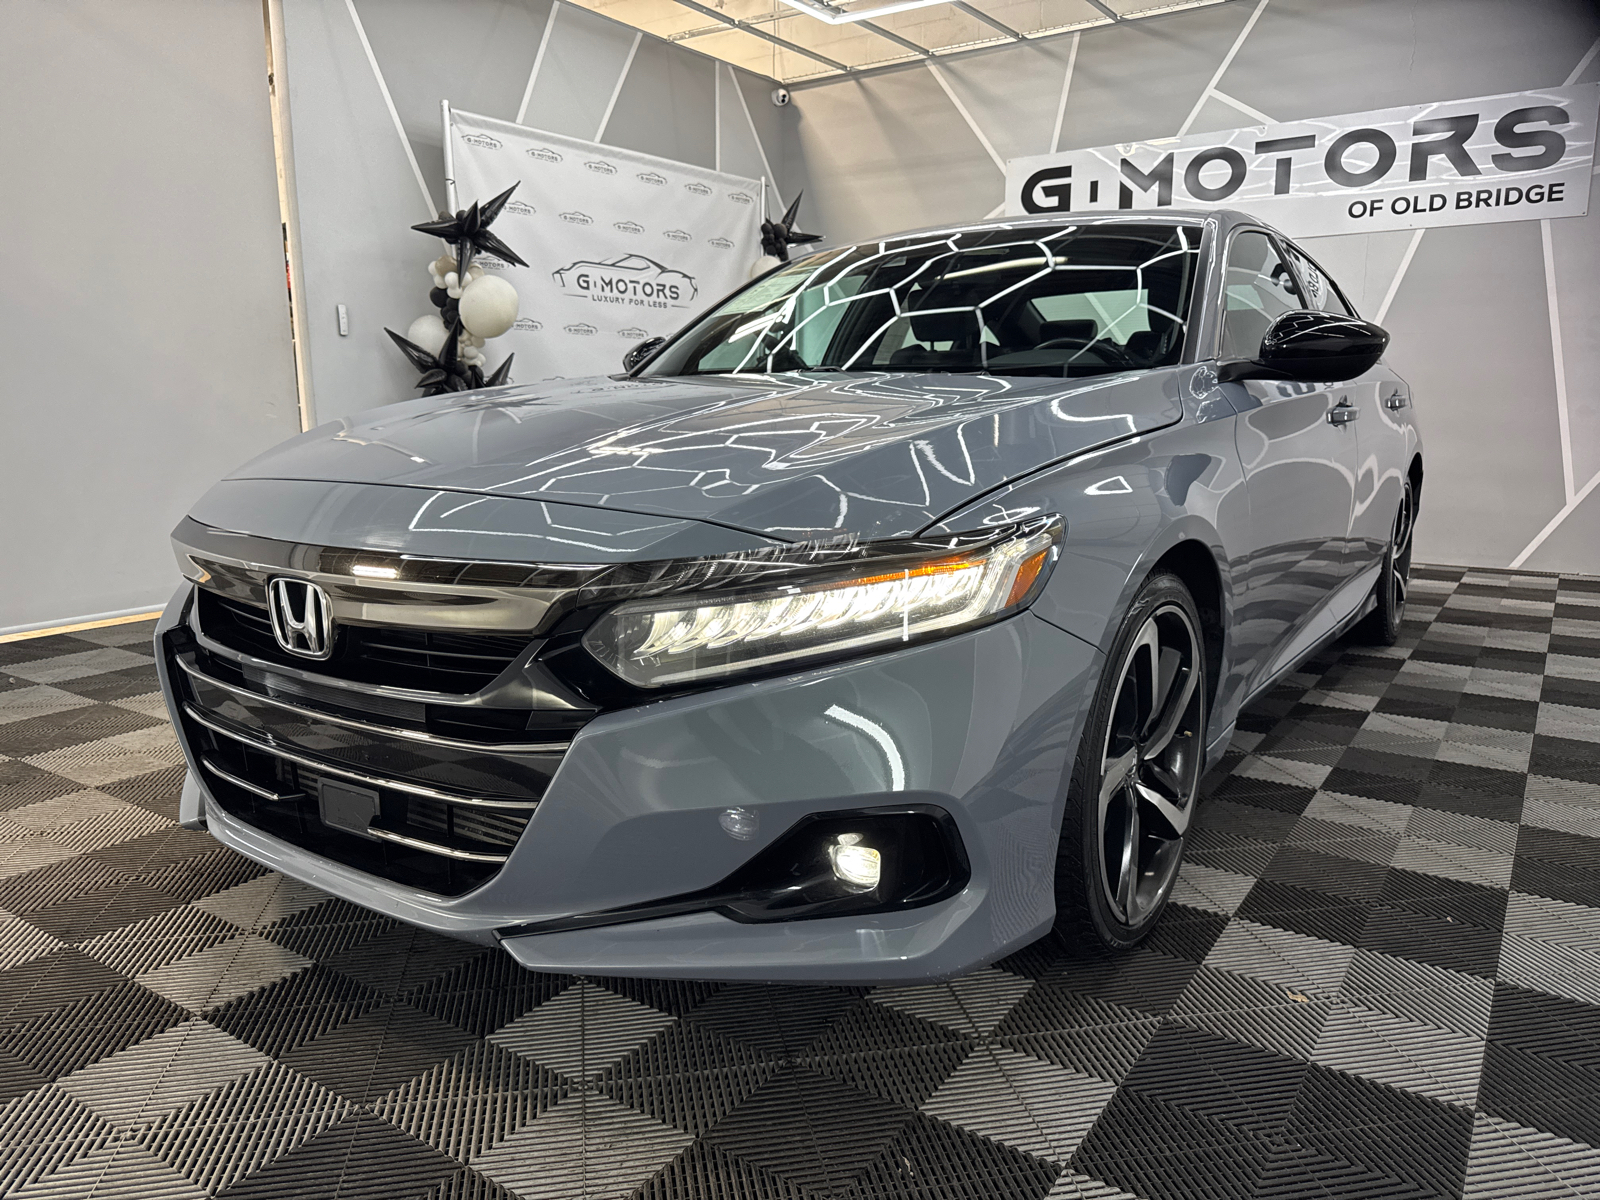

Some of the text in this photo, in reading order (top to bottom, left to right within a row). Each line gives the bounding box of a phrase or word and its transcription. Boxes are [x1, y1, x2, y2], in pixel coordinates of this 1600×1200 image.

[1347, 182, 1566, 220] OF OLD BRIDGE
[591, 294, 668, 309] LUXURY FOR LESS
